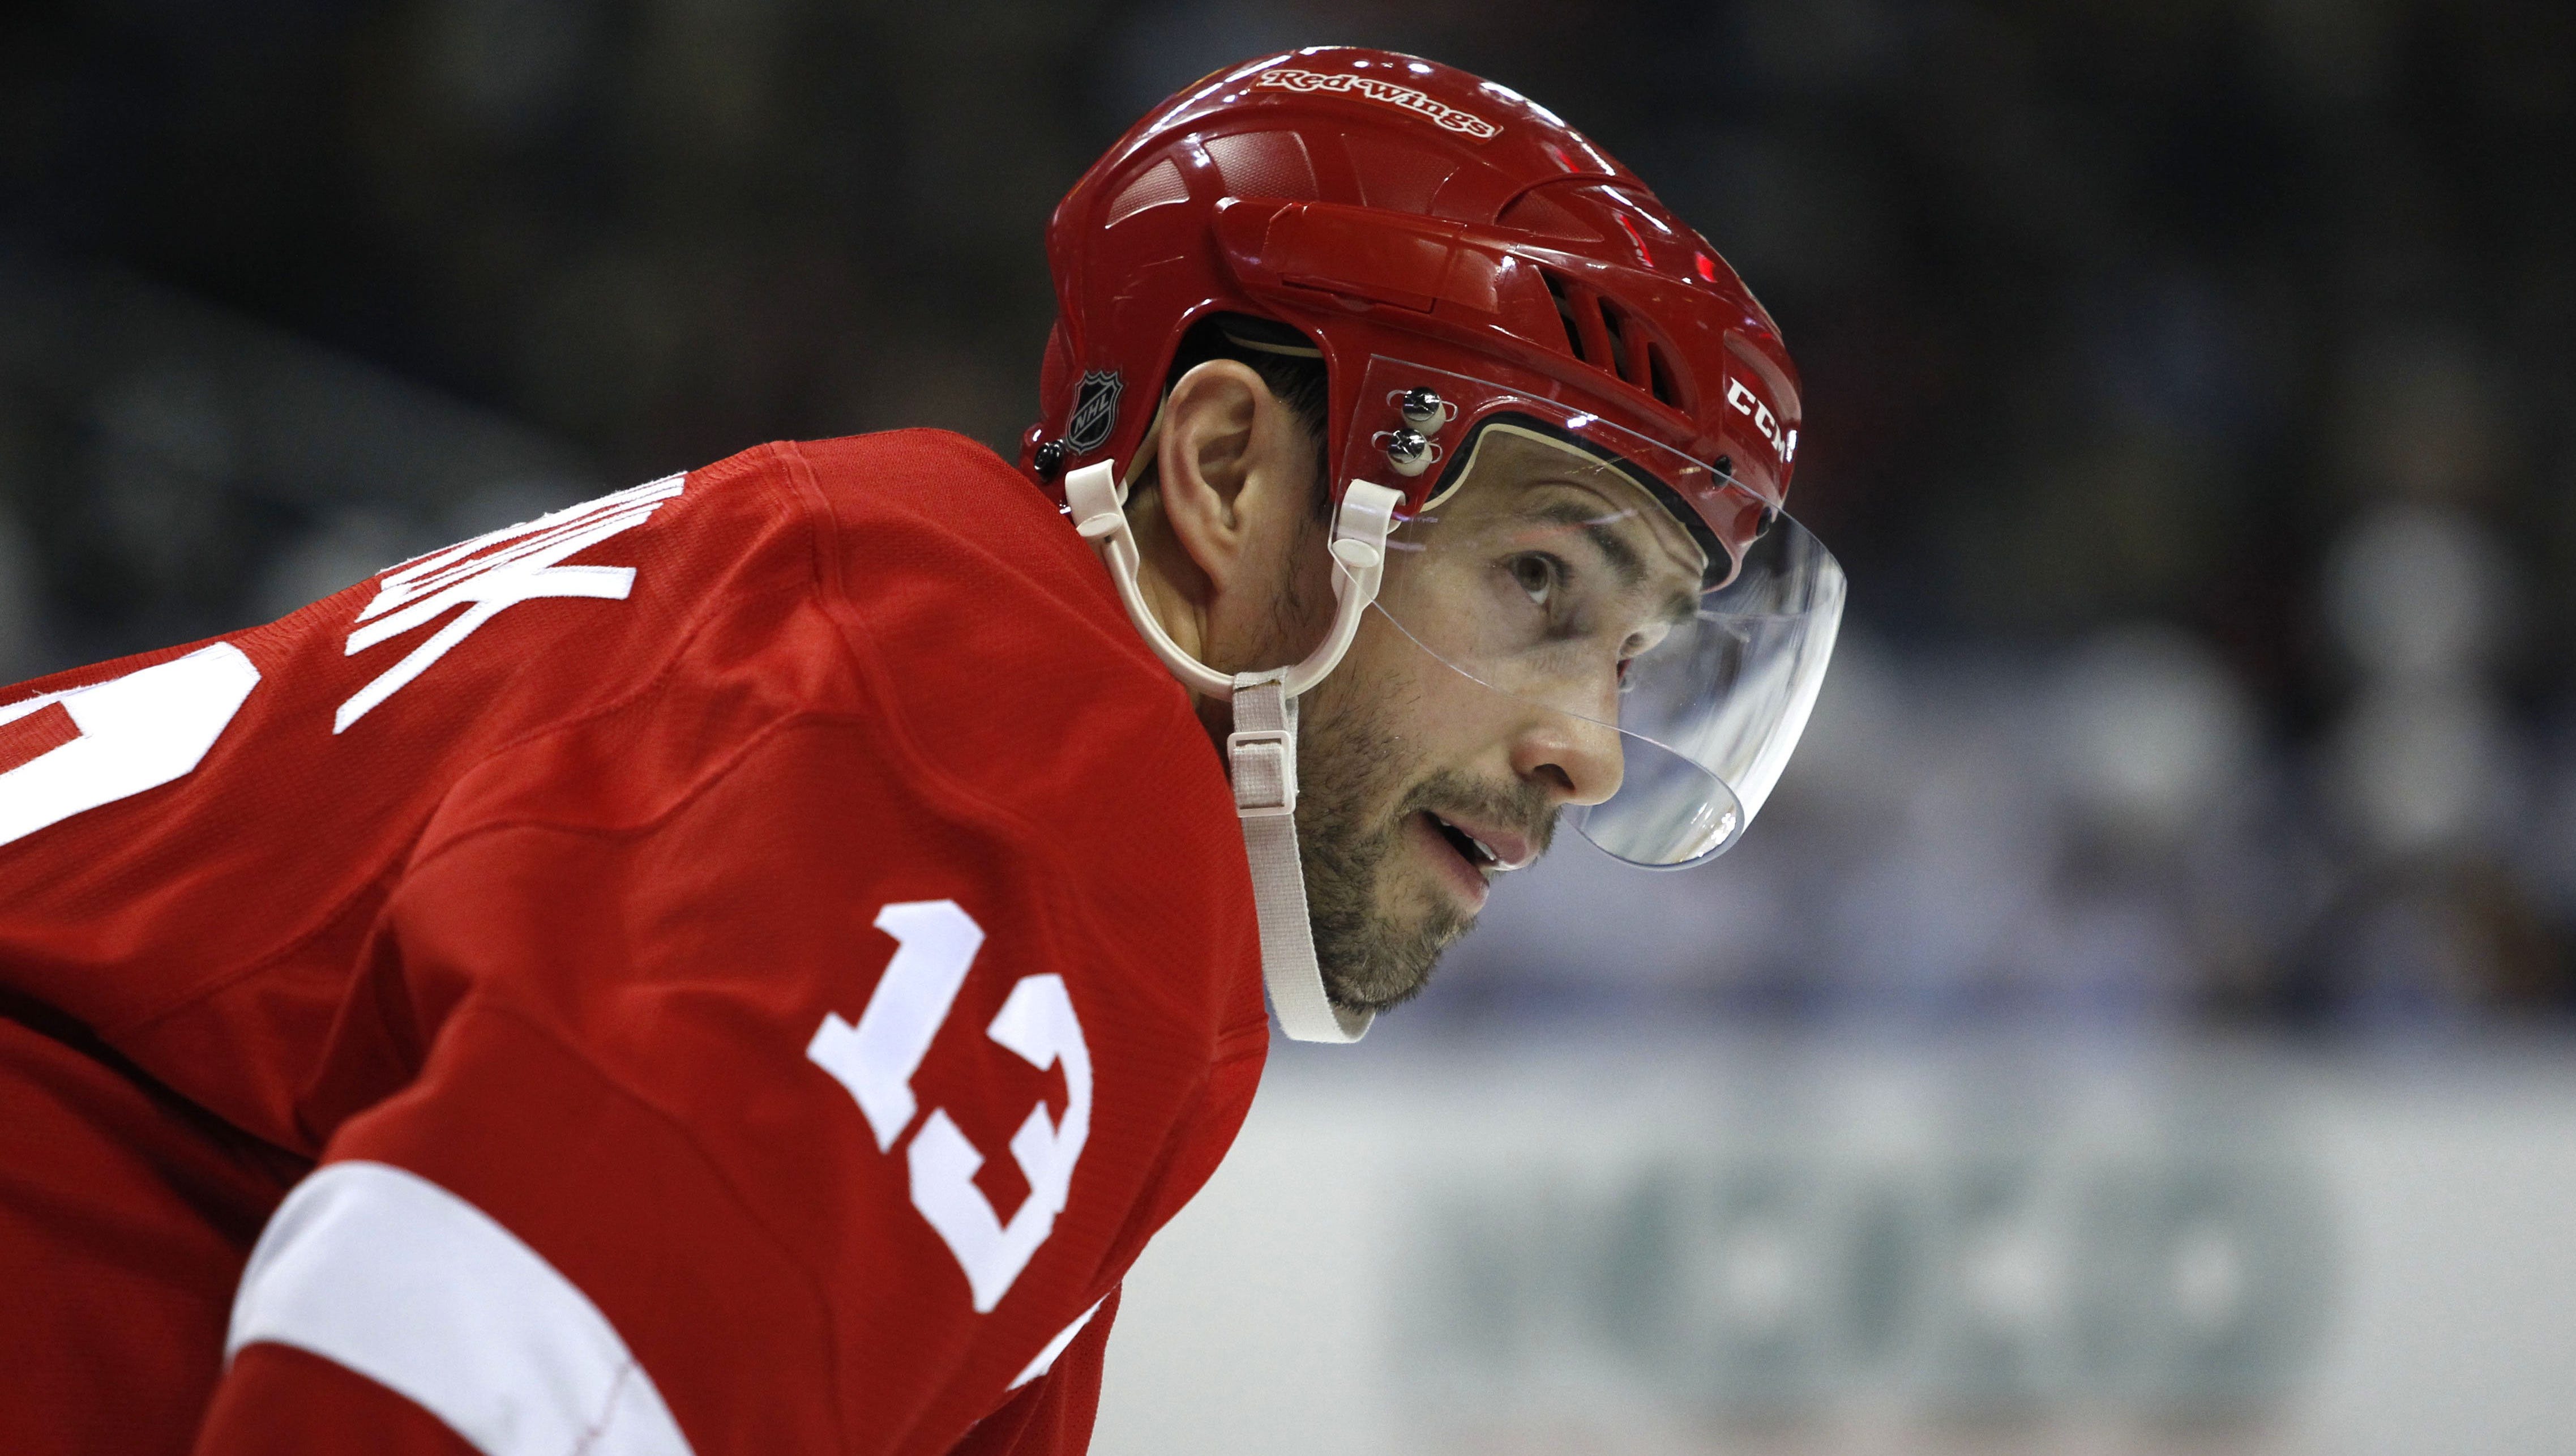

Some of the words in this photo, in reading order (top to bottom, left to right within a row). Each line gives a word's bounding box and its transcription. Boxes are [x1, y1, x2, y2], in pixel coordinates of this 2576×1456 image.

[1257, 70, 1360, 92] Red
[1359, 79, 1495, 138] Wings
[1075, 393, 1109, 435] NHL
[806, 899, 1093, 1314] 13
